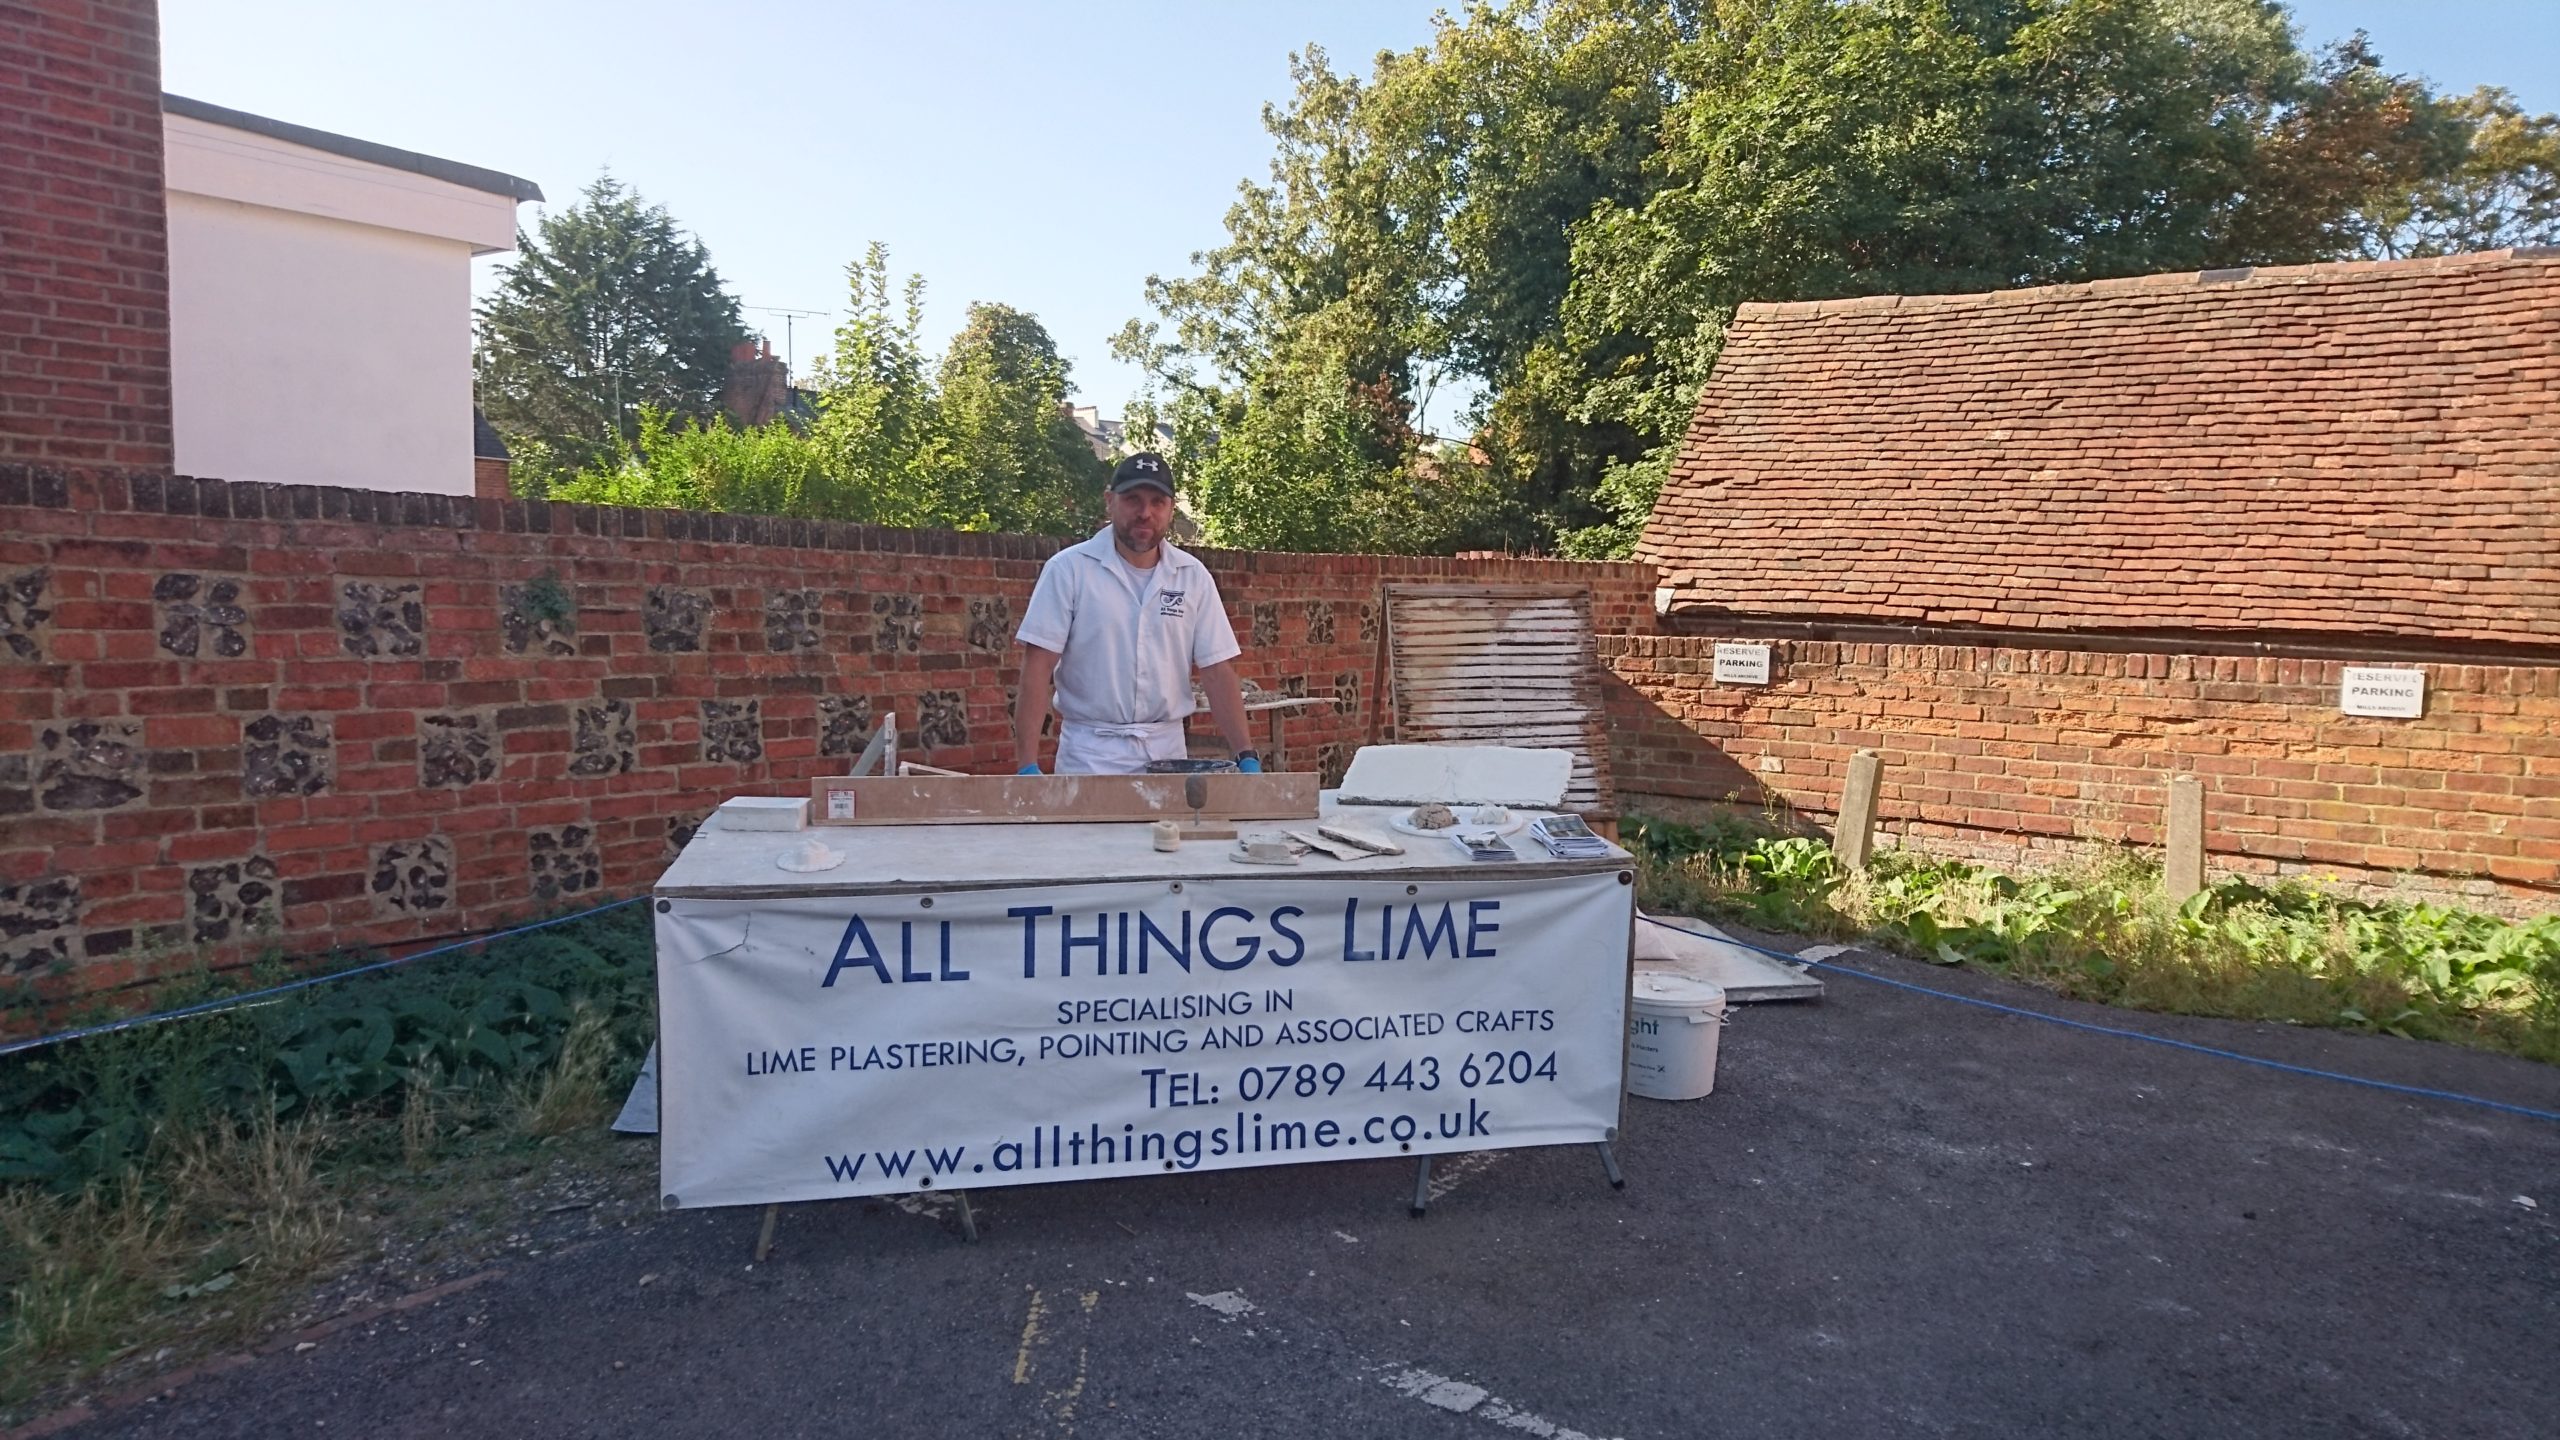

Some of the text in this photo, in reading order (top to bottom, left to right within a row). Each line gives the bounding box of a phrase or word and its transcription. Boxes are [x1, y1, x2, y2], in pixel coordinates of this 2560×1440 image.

[1719, 659, 1764, 668] PARKING
[2351, 672, 2417, 683] ESERV
[2352, 686, 2415, 698] PARKING
[821, 897, 1501, 988] ALL THINGS LIME
[1057, 988, 1294, 1025] SPECIALISING IN
[747, 1009, 1555, 1076] LIME PLASTERING, POINTING AND ASSOCIATED CRAFTS
[1141, 1050, 1558, 1109] TEL: 0789 443 6204
[824, 1098, 1492, 1184] www.allthingslime.co.uk
